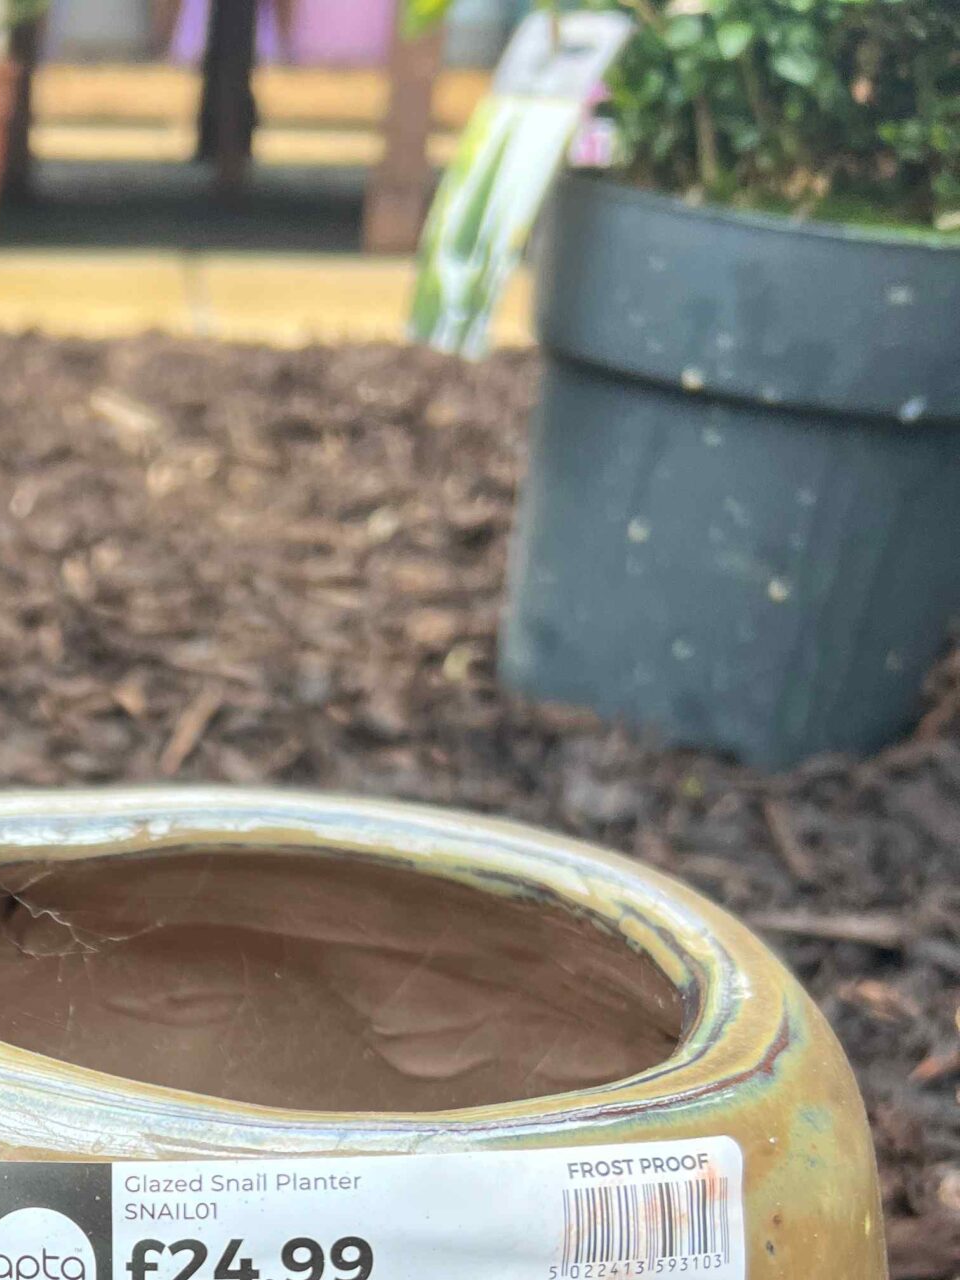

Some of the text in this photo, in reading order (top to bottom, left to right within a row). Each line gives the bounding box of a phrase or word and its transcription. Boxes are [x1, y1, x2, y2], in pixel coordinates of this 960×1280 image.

[566, 1152, 709, 1180] FROST PROOF
[124, 1172, 362, 1193] Glazed Snail Planter
